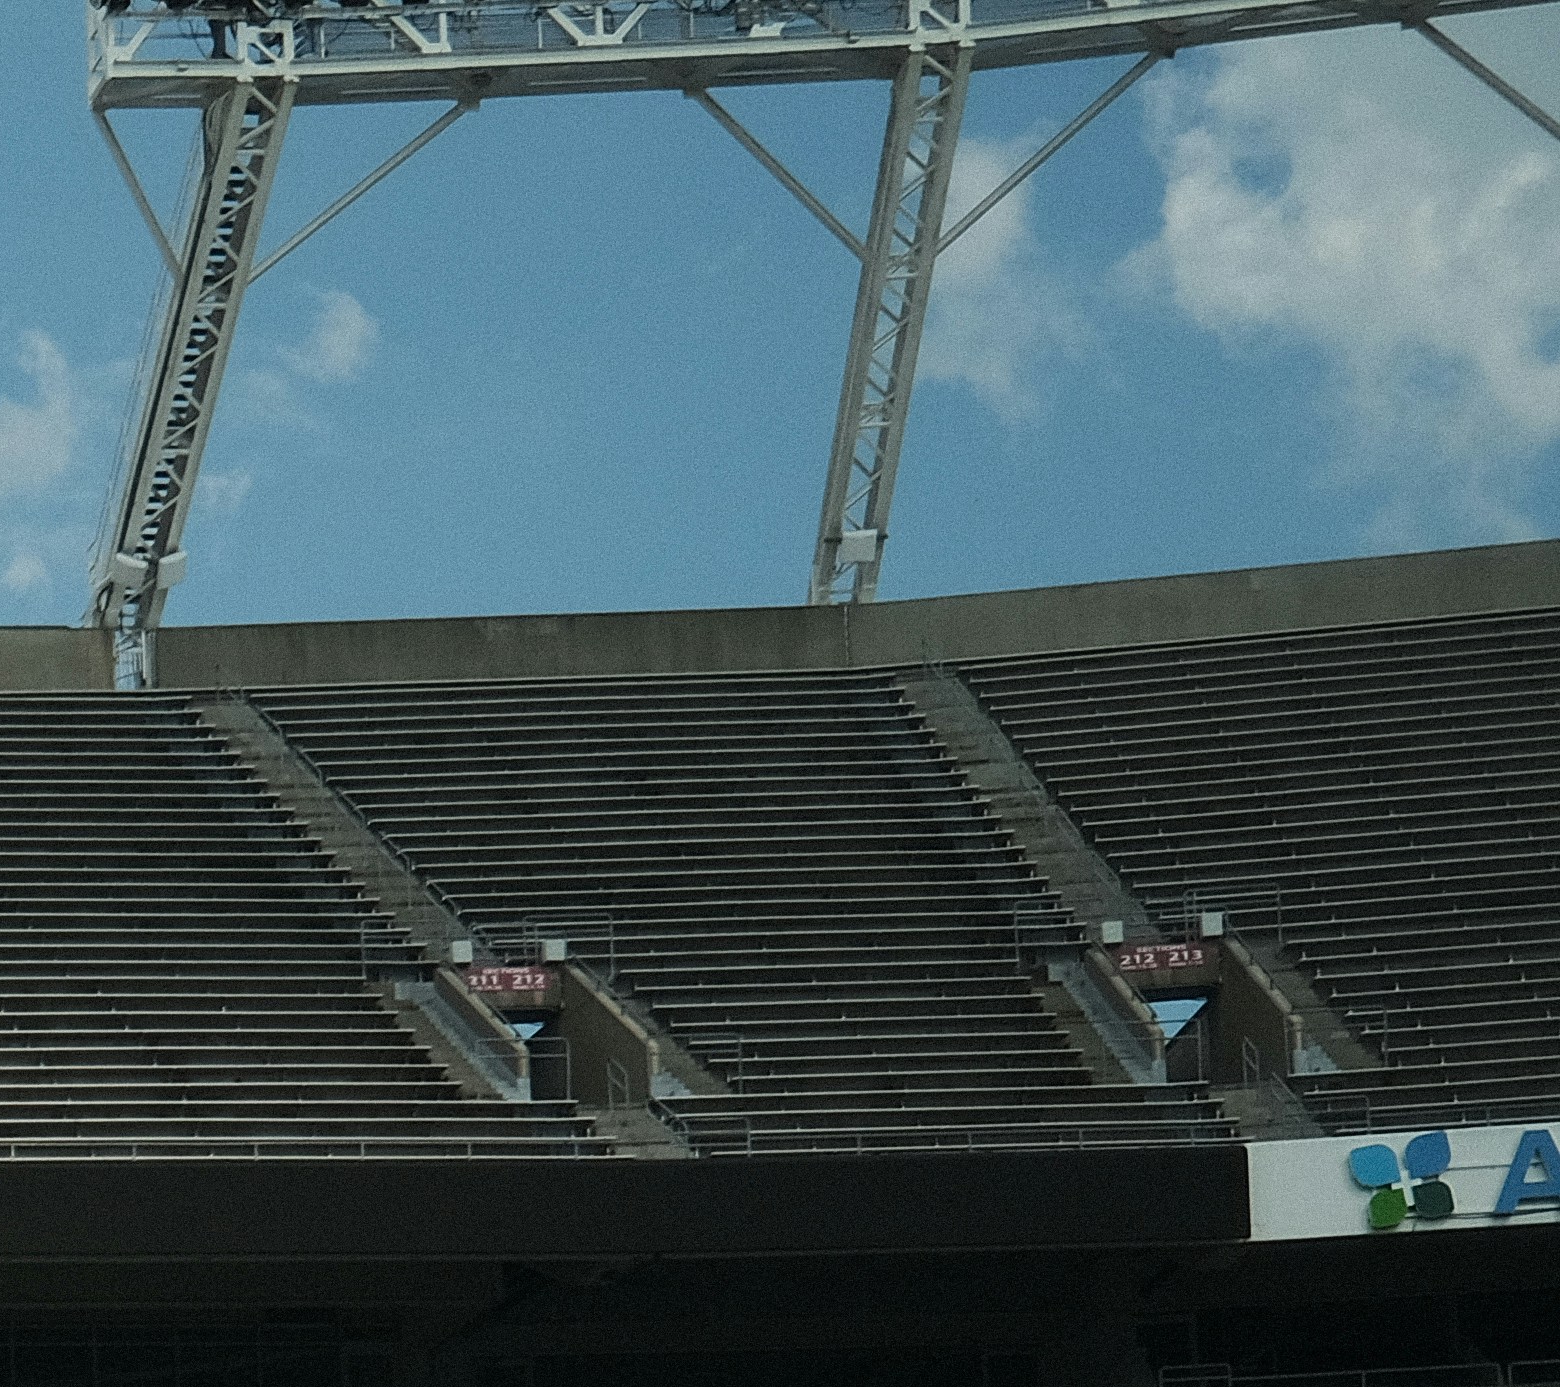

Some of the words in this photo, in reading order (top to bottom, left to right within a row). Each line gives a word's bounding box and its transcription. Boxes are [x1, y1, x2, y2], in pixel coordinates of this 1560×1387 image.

[1120, 954, 1154, 965] 212
[1169, 950, 1202, 962] 213
[512, 974, 545, 984] 212
[1493, 1129, 1560, 1216] A
